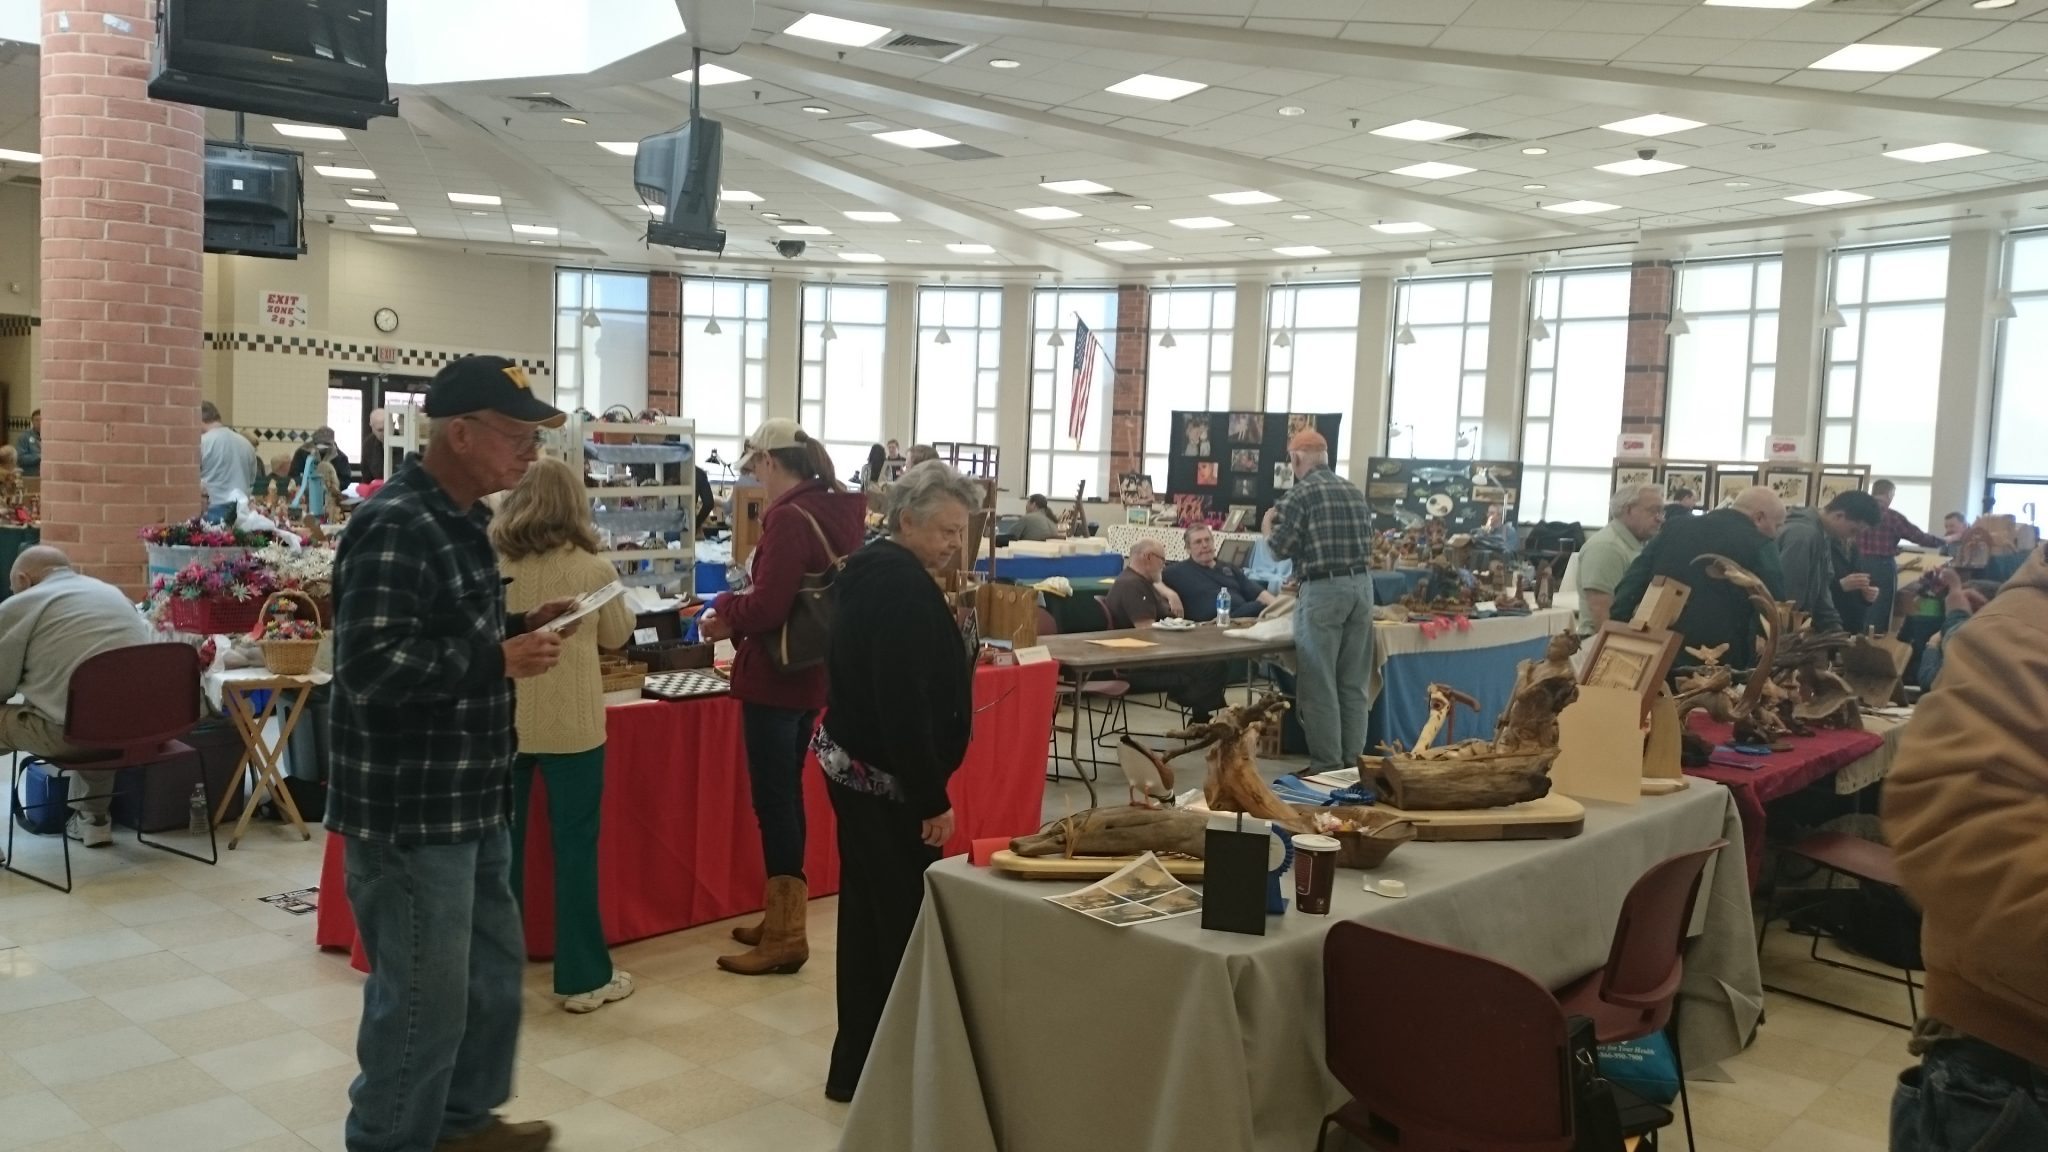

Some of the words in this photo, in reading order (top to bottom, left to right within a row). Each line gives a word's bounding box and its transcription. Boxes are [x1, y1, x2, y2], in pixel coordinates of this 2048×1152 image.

[267, 294, 299, 305] EXIT
[267, 305, 295, 315] ZONE
[271, 314, 278, 322] 2
[288, 319, 295, 327] 3
[379, 347, 396, 360] EXIT
